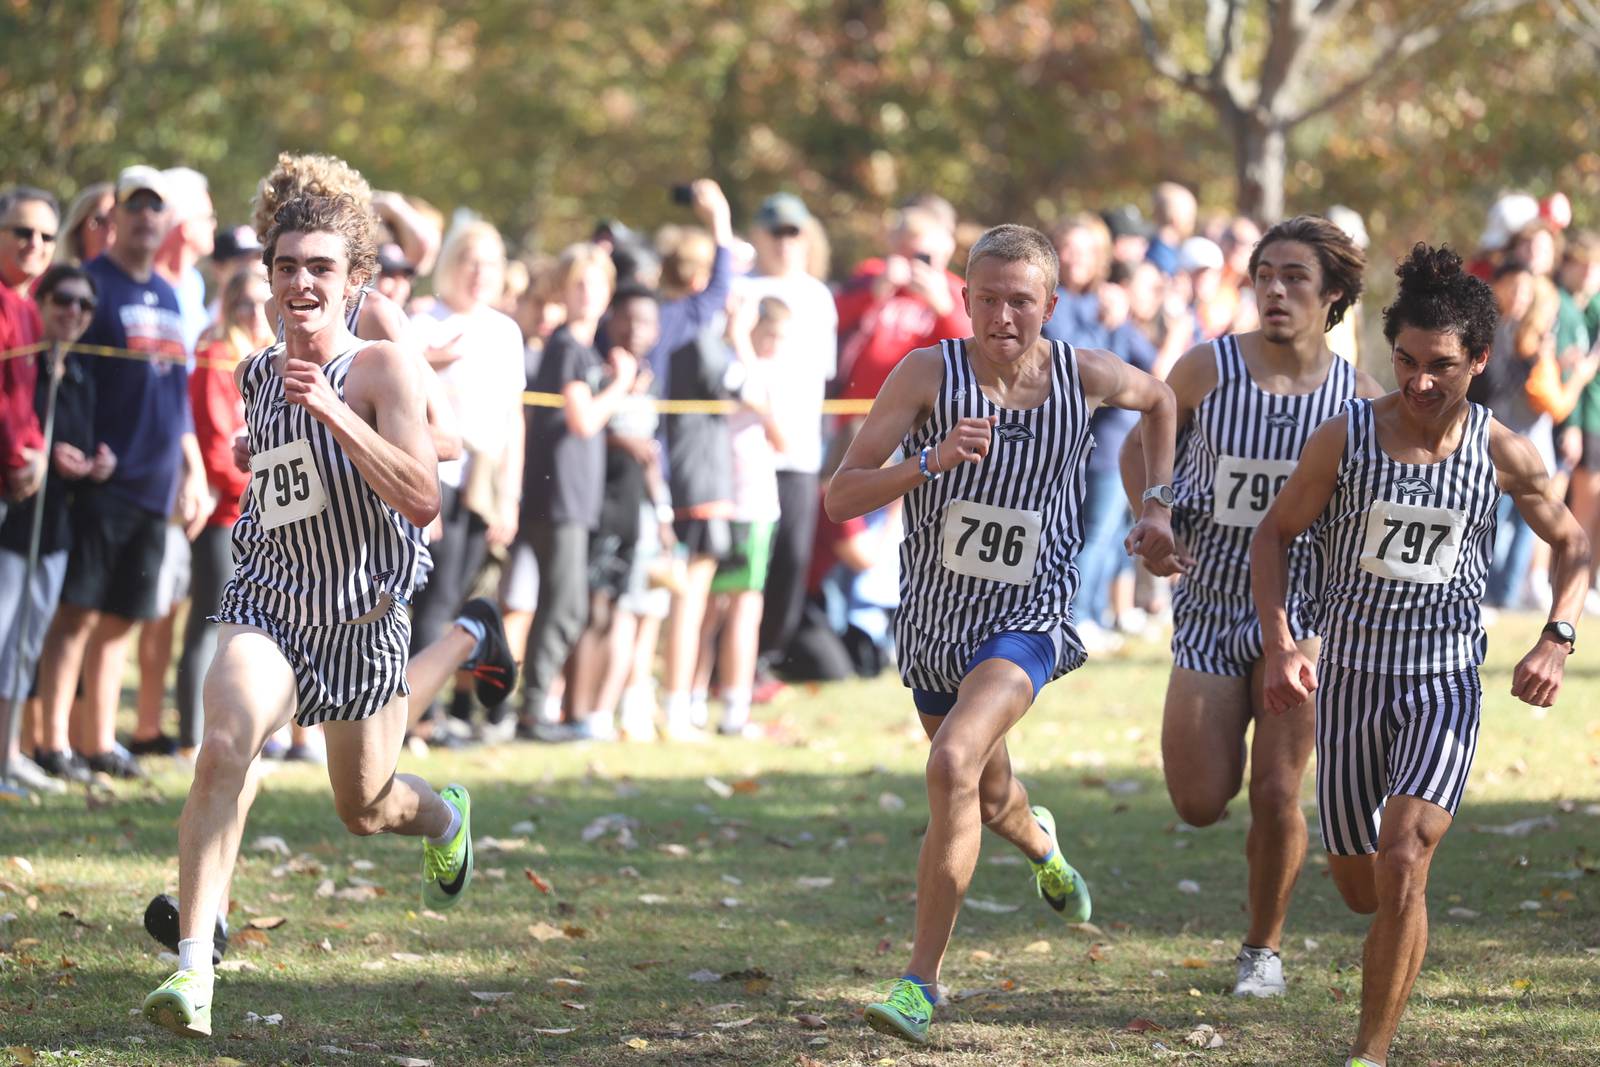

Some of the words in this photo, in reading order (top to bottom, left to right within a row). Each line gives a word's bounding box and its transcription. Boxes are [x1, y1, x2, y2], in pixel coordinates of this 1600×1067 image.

[255, 457, 310, 512] 795
[955, 516, 1026, 567] 796
[1376, 518, 1451, 566] 797
